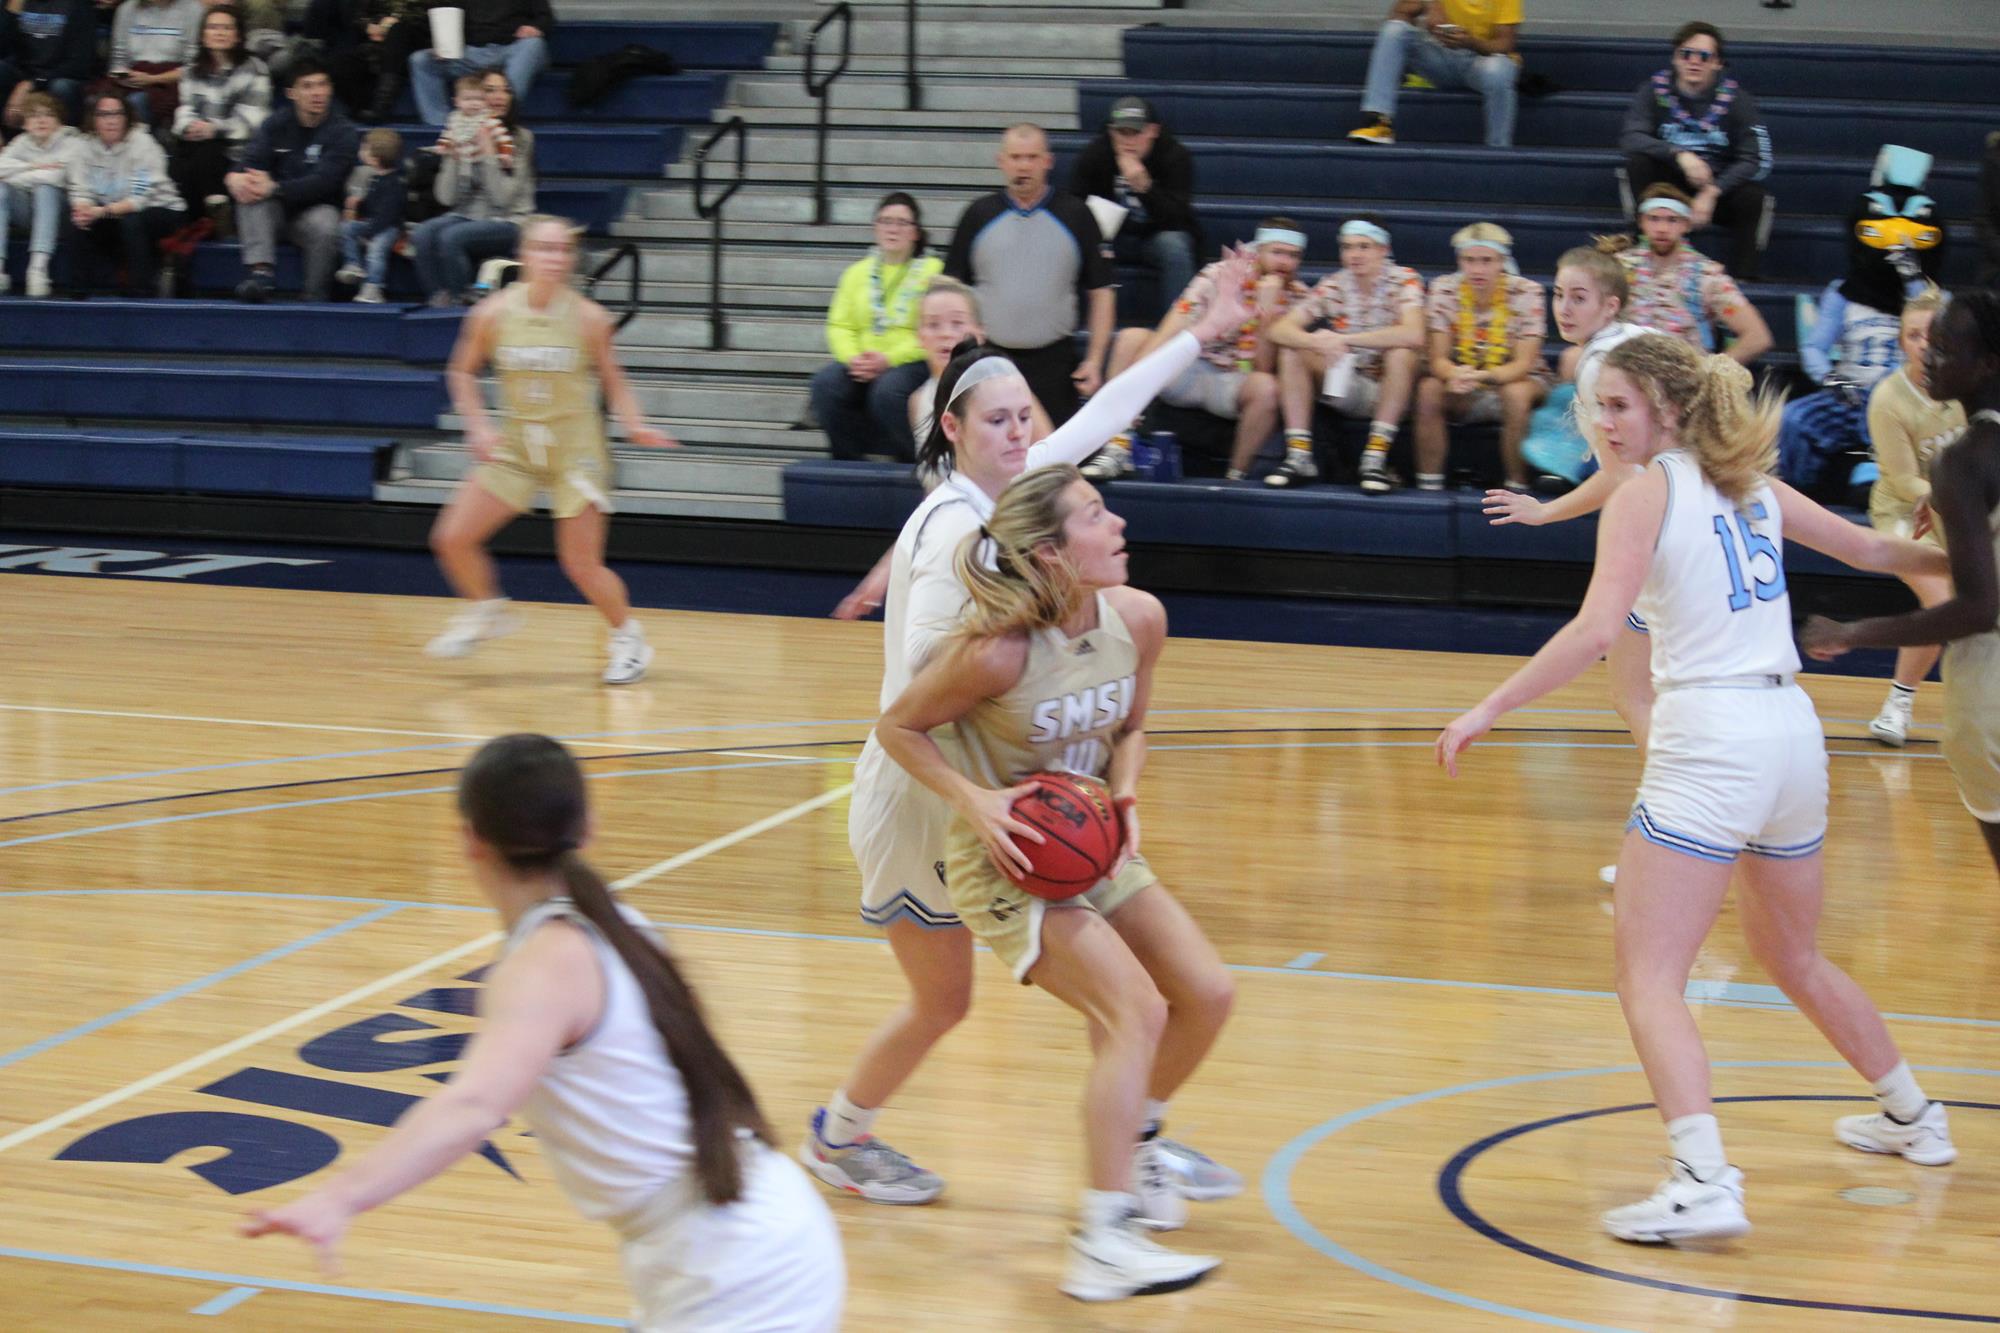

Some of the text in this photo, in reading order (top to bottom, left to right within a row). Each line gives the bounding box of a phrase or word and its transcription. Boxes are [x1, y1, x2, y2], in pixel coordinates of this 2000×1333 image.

[0, 544, 335, 578] RT
[1713, 501, 1785, 611] 15
[54, 963, 493, 1195] SIC
